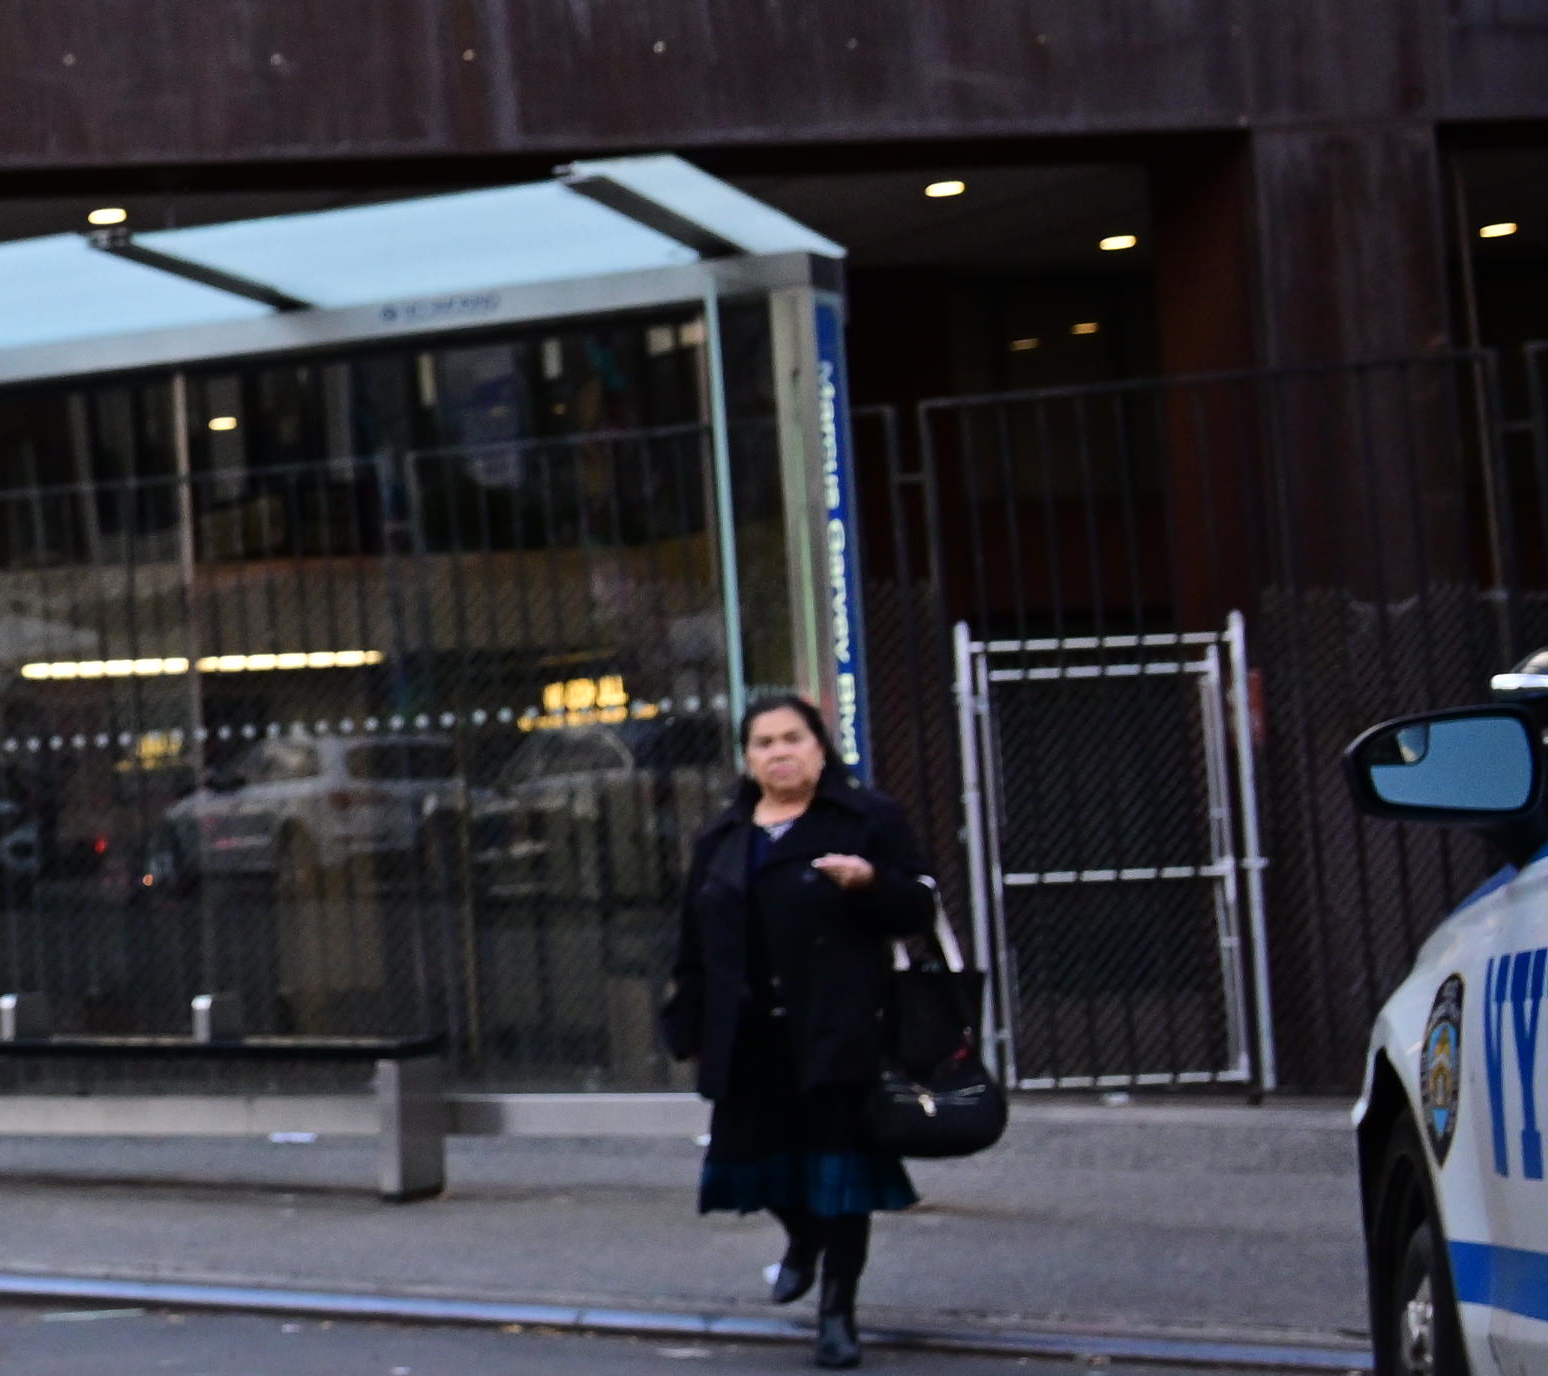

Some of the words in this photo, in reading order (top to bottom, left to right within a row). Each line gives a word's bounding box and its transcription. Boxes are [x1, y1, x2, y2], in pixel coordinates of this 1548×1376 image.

[818, 361, 840, 510] Marcus
[827, 518, 850, 663] Garvey
[837, 673, 860, 765] Blvd
